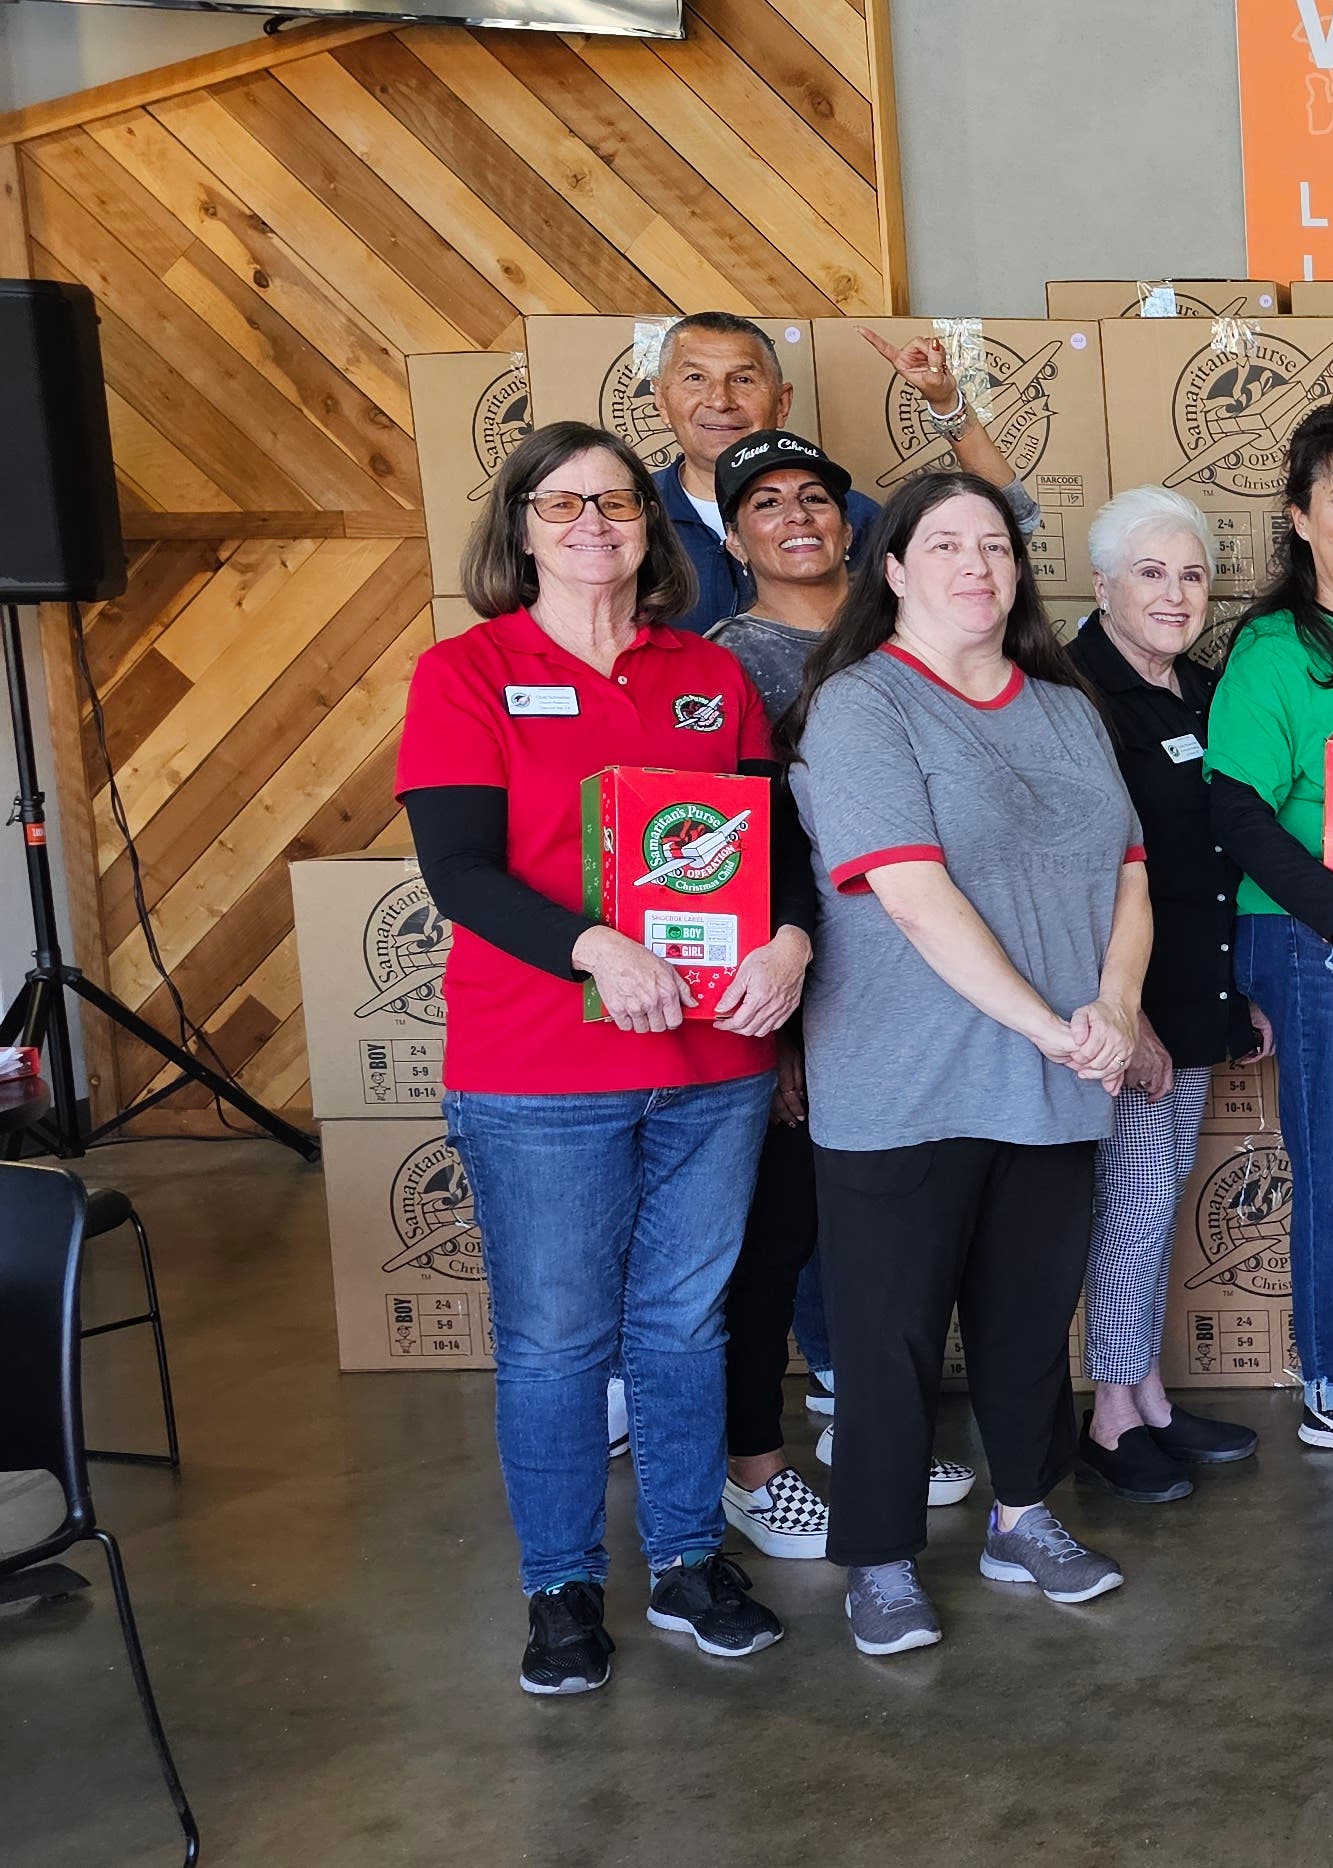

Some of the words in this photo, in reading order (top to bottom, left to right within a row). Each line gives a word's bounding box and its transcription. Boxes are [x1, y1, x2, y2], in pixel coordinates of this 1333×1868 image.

[1014, 435, 1040, 471] Child
[1040, 476, 1079, 485] BARCODE
[1217, 517, 1234, 530] 2-4
[1031, 541, 1047, 552] 5-9
[650, 806, 686, 868] Samaritan's
[687, 804, 721, 828] Purse
[686, 844, 737, 879] OPERATION
[675, 877, 719, 893] Christmas
[717, 860, 736, 881] Child
[377, 884, 430, 984] Samaritan's
[683, 926, 702, 939] BOY
[681, 945, 703, 957] GIRL
[367, 1043, 388, 1070] BOY
[410, 1045, 427, 1056] 2-4
[412, 1066, 429, 1077] 5-9
[1229, 1080, 1246, 1091] 5-9
[408, 1087, 436, 1098] 10-14
[1224, 1101, 1253, 1113] 10-14
[402, 1144, 455, 1240] Samaritan's
[393, 1297, 413, 1323] BOY
[435, 1300, 451, 1310] 2-4
[436, 1319, 453, 1330] 5-9
[1236, 1316, 1252, 1326] 2-4
[1195, 1314, 1214, 1342] BOY
[432, 1340, 460, 1350] 10-14
[1237, 1336, 1253, 1347] 5-9
[1232, 1357, 1260, 1367] 10-14
